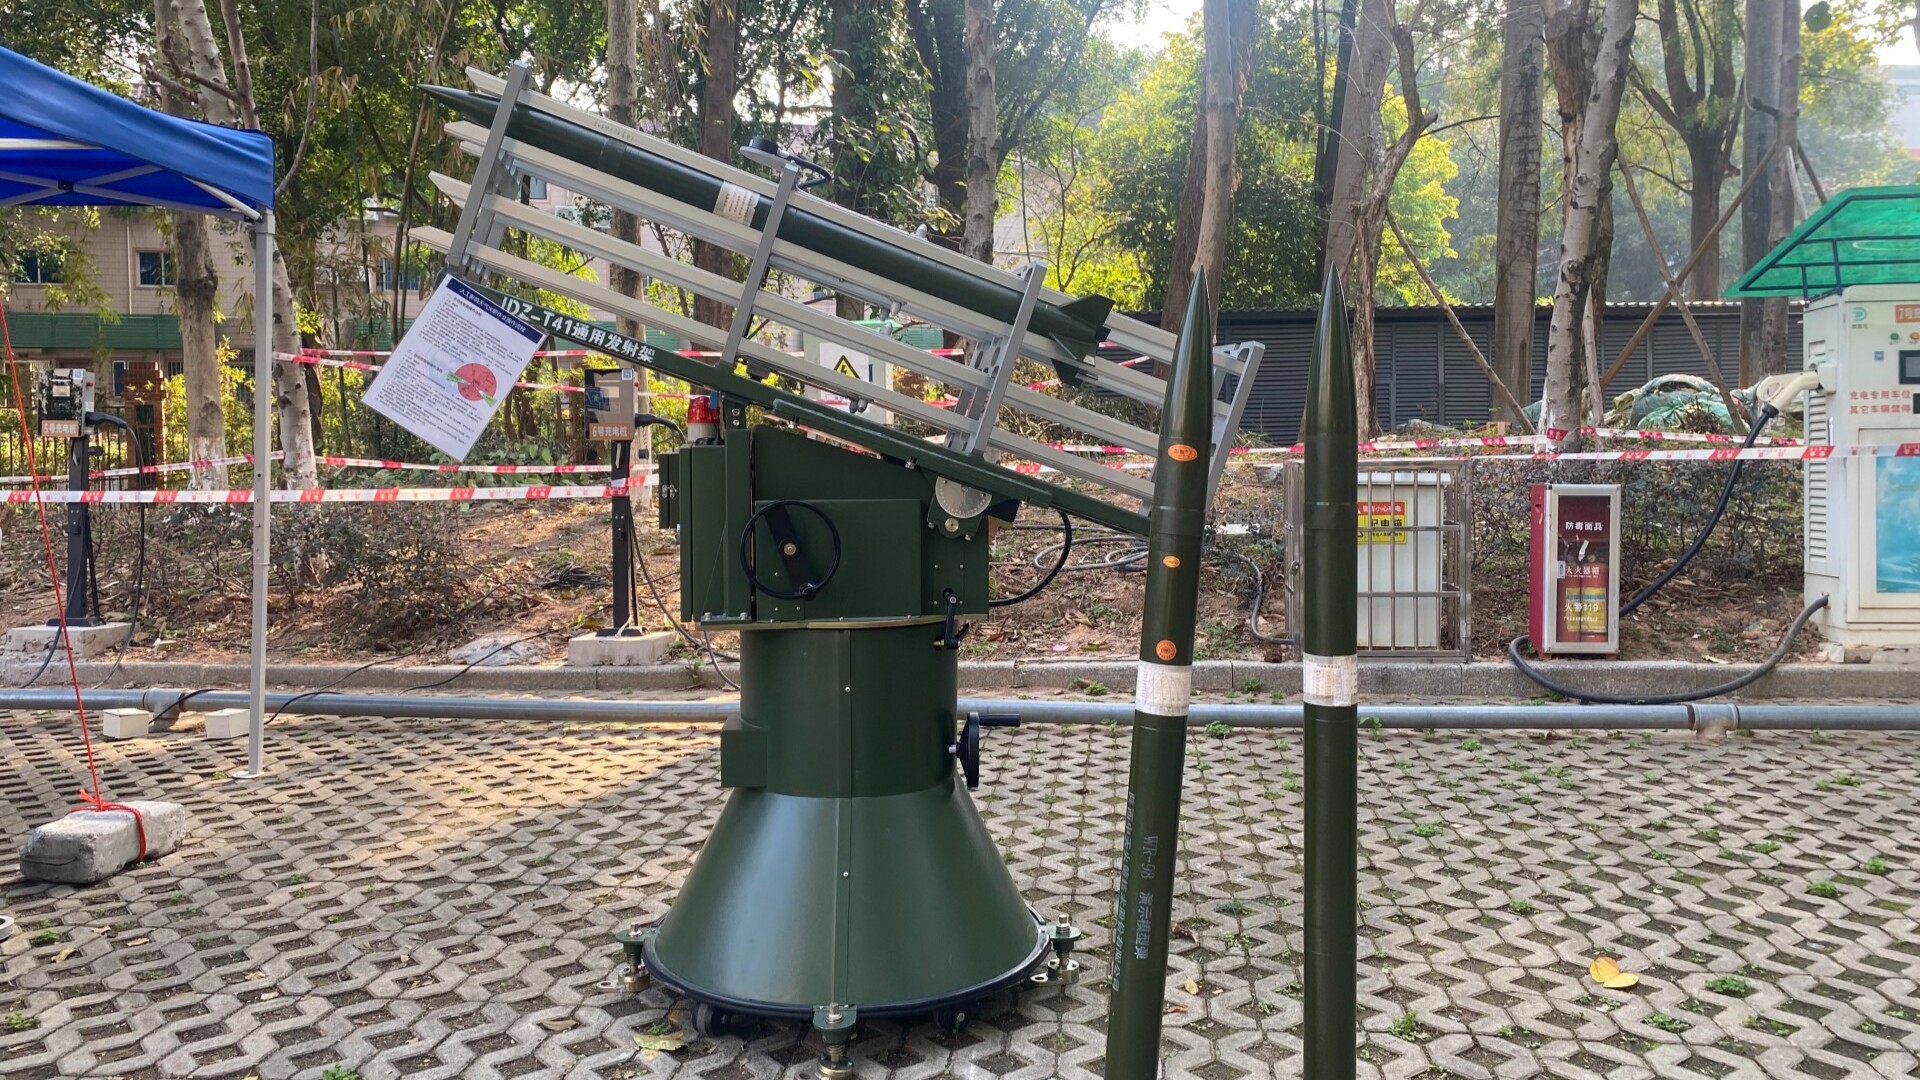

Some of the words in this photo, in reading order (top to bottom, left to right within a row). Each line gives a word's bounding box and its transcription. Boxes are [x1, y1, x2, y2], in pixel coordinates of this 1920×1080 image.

[592, 426, 627, 437] 6号充电桩
[1565, 521, 1603, 531] 防毒面具
[1564, 602, 1599, 612] 火警119
[1140, 836, 1159, 880] WR-98
[1134, 892, 1153, 960] 演示模型弹
